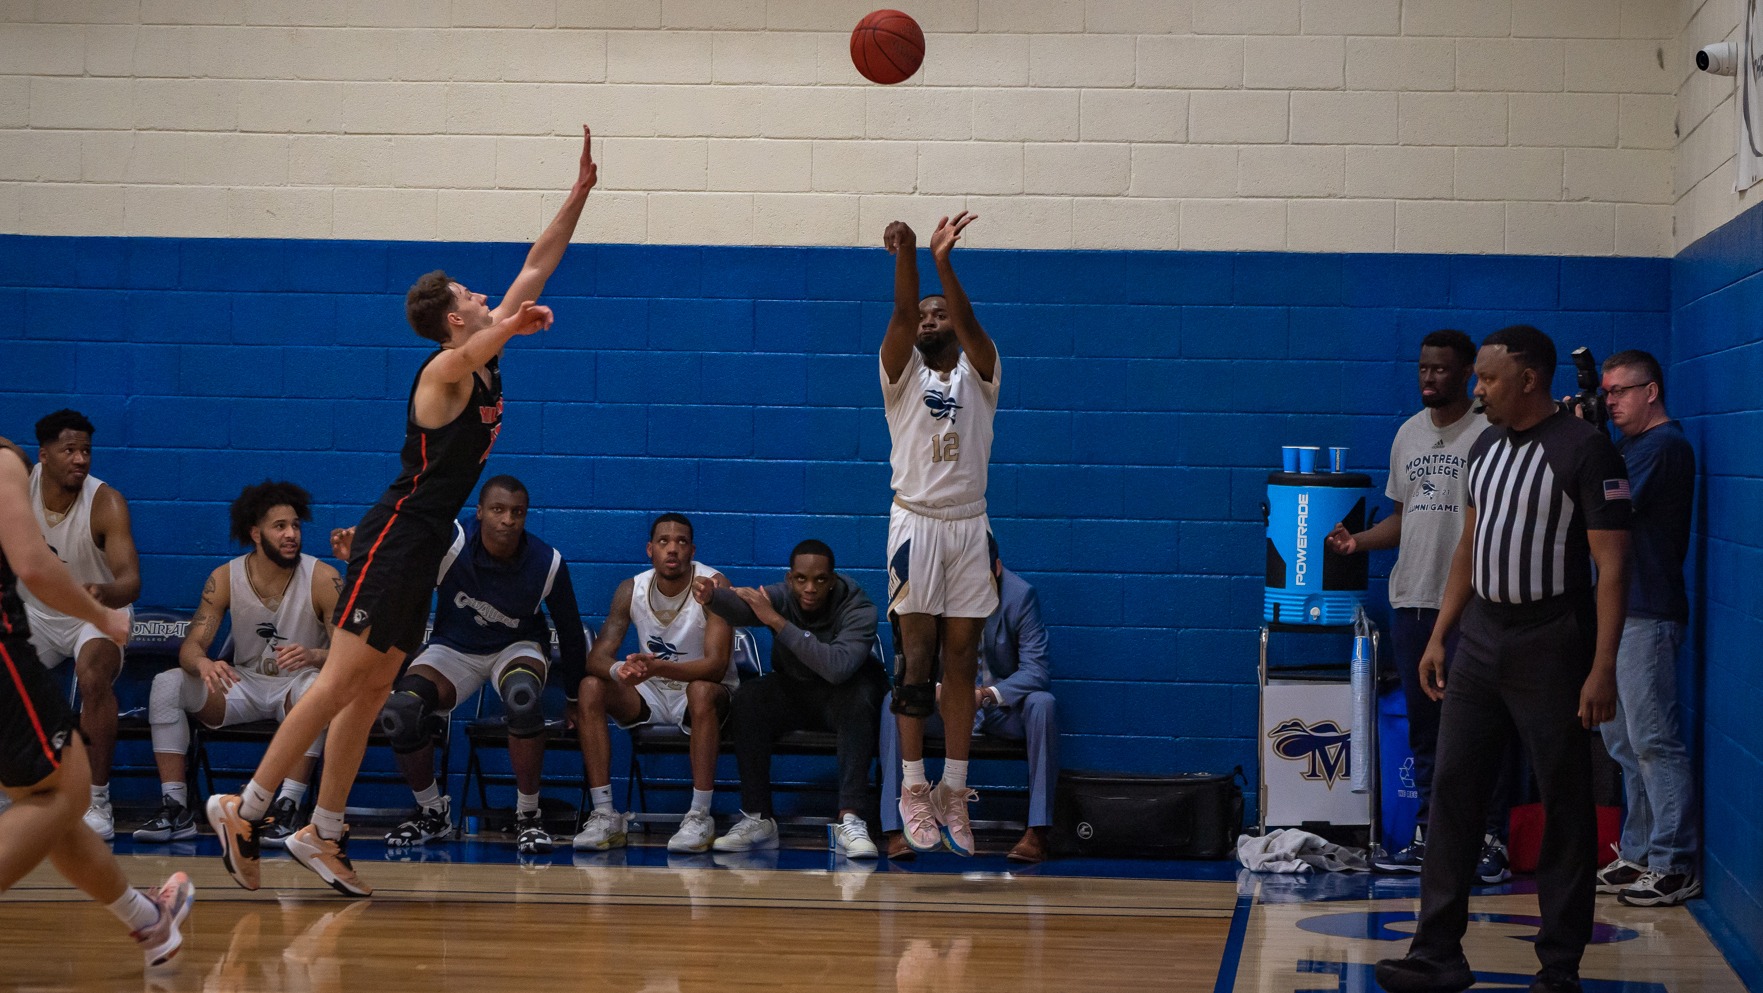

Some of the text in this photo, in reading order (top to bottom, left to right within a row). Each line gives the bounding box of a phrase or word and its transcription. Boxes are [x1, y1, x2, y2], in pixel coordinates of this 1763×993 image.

[932, 432, 960, 463] 12
[1405, 454, 1467, 474] MONTREAT
[1409, 465, 1459, 482] COLLEGE
[1430, 503, 1459, 513] GAME
[1295, 493, 1309, 586] POWERADE
[132, 620, 191, 638] ONTREAT
